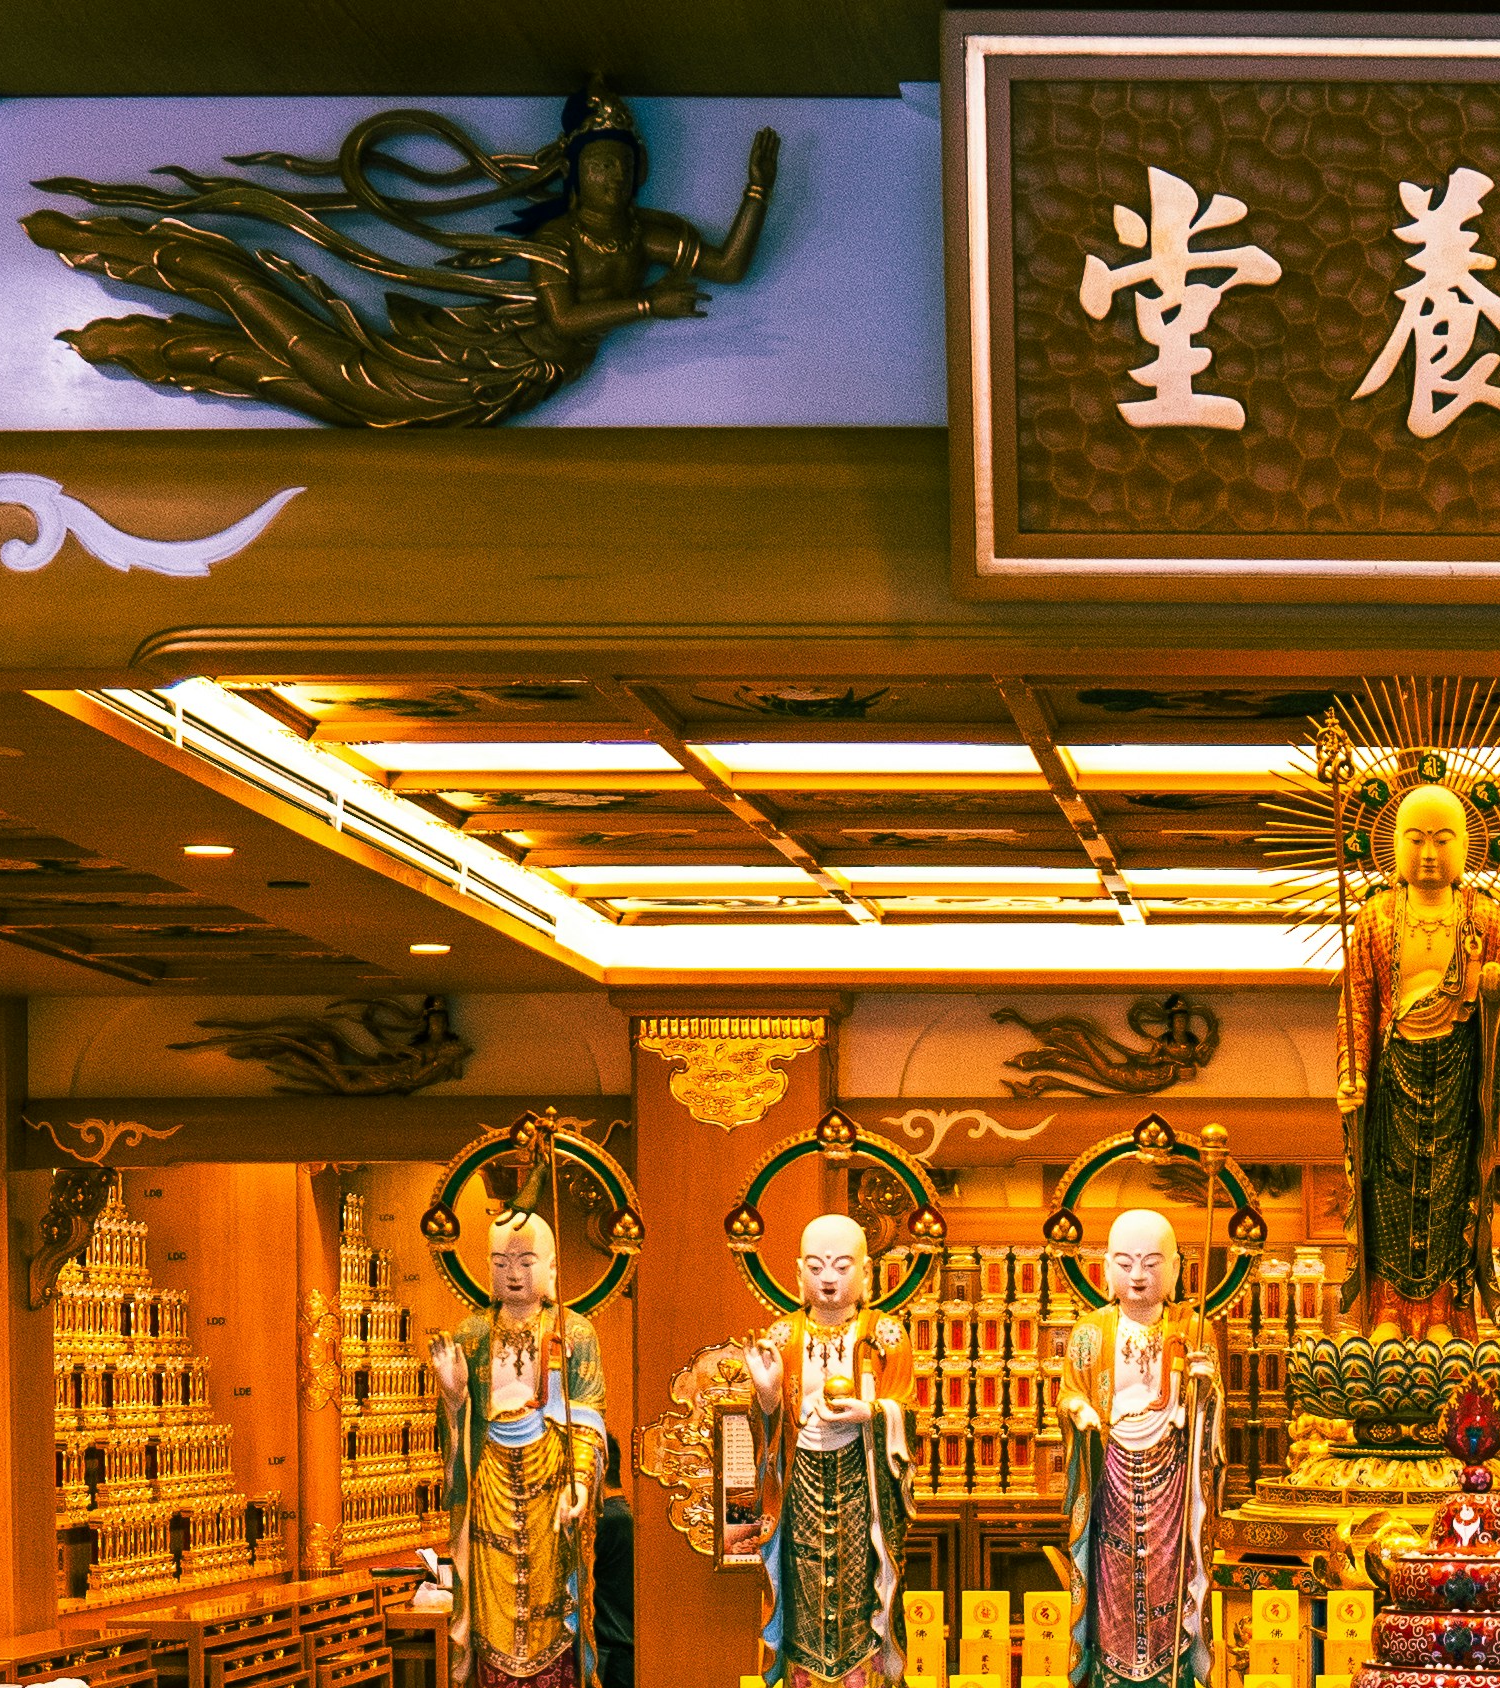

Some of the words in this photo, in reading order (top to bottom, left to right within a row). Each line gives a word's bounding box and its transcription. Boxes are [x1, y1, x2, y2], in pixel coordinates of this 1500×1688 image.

[269, 1456, 285, 1465] LDF
[280, 1511, 296, 1519] DG
[1270, 1629, 1284, 1639] 佛
[1345, 1628, 1358, 1638] 佛
